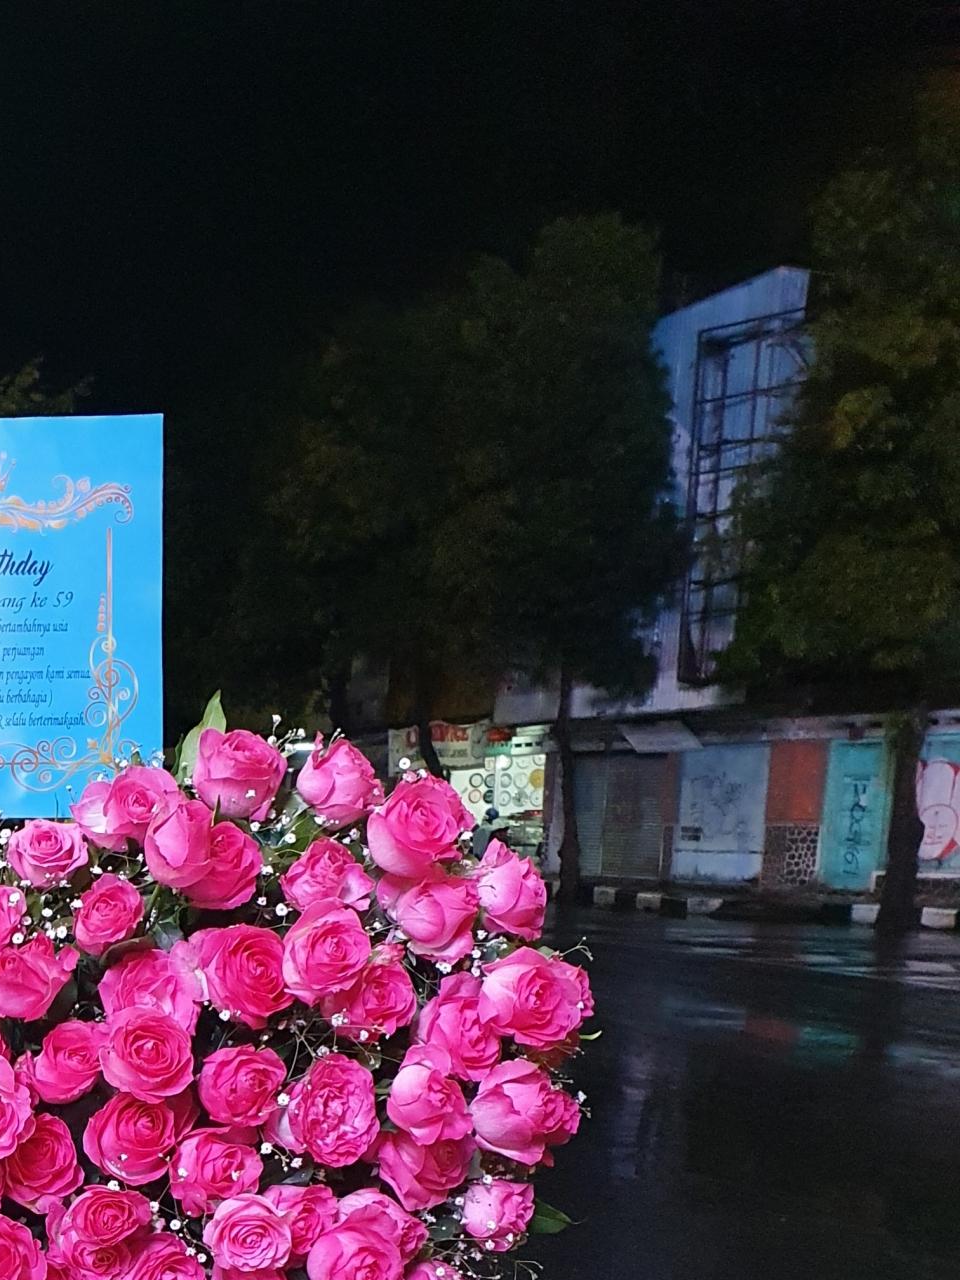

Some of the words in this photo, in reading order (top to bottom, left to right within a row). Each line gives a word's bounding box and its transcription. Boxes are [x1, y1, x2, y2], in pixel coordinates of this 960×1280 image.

[30, 592, 48, 608] ke
[52, 591, 74, 608] 59
[52, 620, 68, 632] usia
[2, 644, 44, 661] perjuangan
[6, 670, 43, 685] pengayom
[45, 664, 65, 683] kami
[5, 712, 26, 726] selalu
